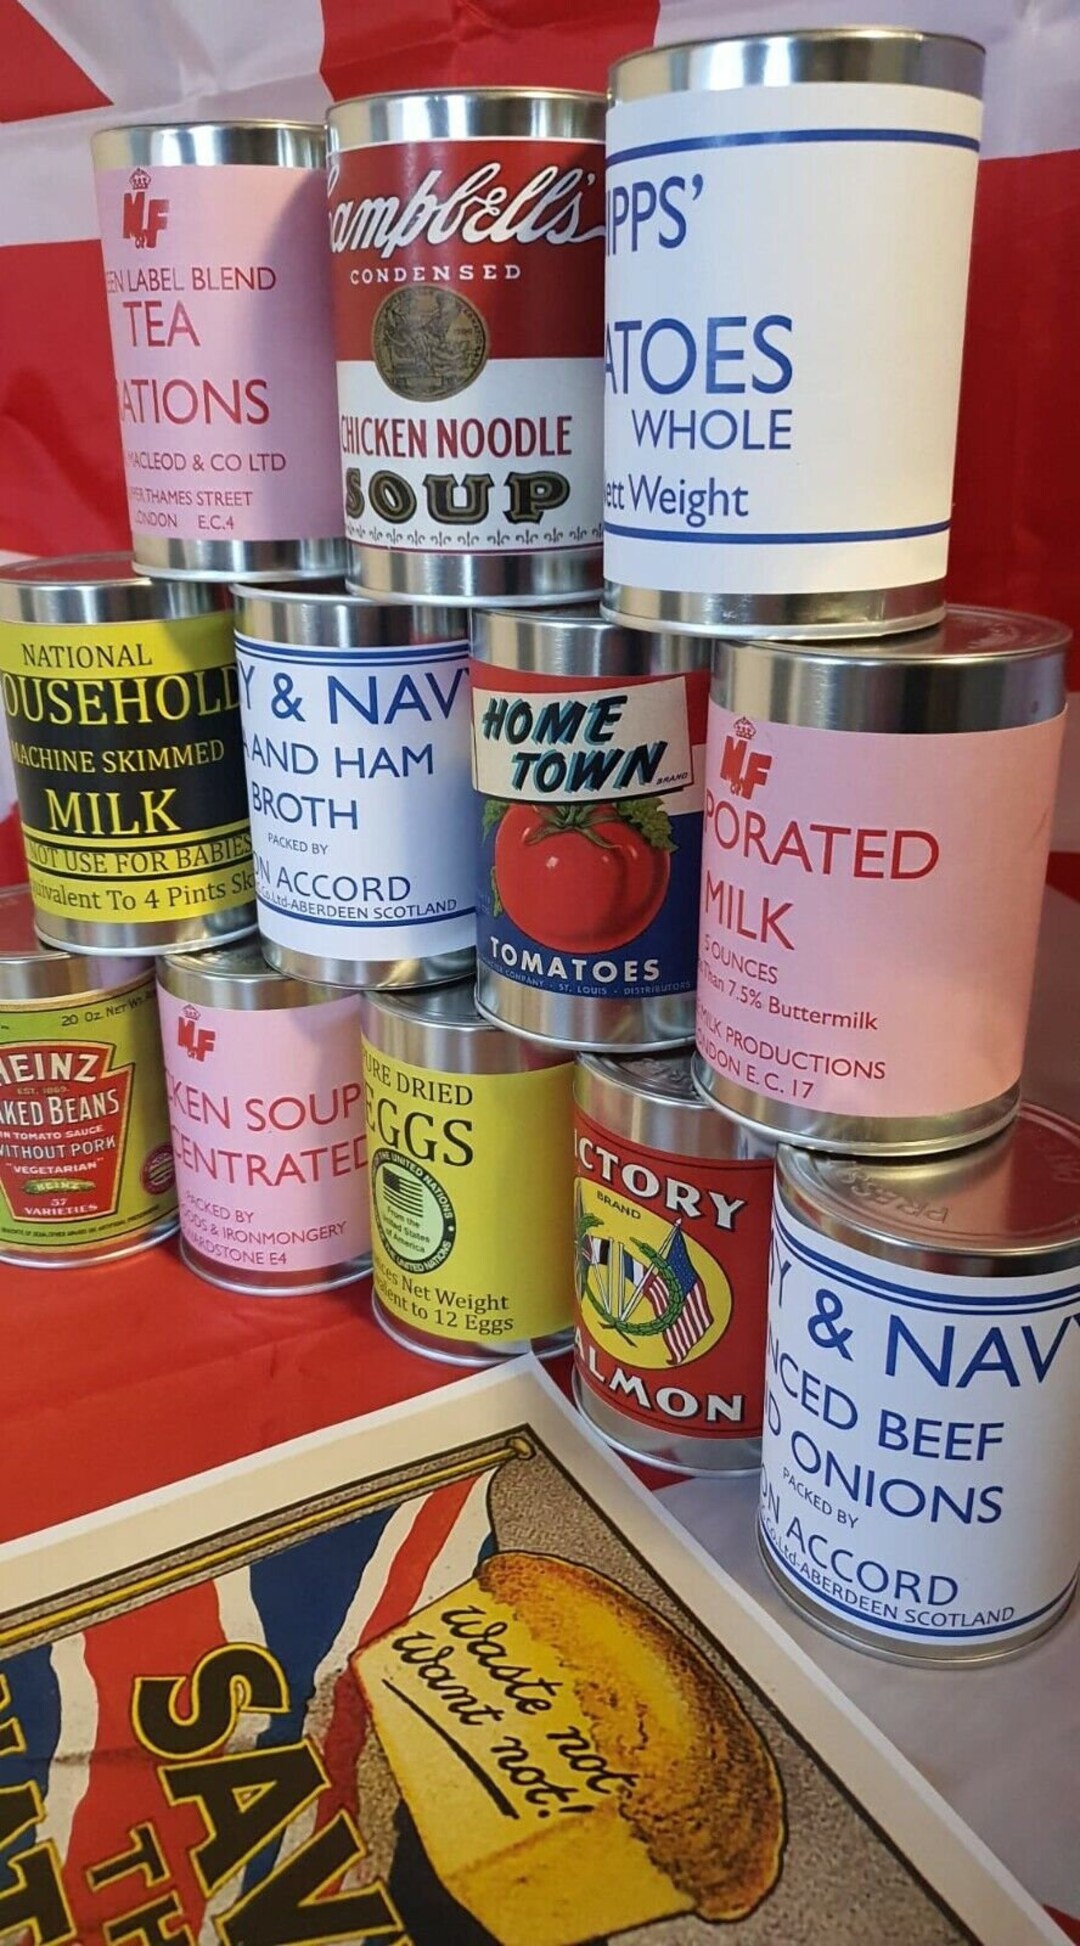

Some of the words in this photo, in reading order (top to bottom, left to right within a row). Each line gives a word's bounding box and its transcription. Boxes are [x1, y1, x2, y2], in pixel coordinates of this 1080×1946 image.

[128, 267, 185, 292] LABEL
[192, 266, 277, 292] BLEND
[350, 263, 521, 285] CONDENSED
[123, 300, 201, 348] TEA
[121, 378, 270, 425] ATIONS
[341, 416, 428, 458] CHICKEN
[438, 415, 573, 458] NOODLE
[631, 408, 793, 450] WHOLE
[193, 454, 205, 472] &
[210, 453, 243, 472] CO
[249, 453, 287, 472] LTD
[145, 488, 193, 506] THAMES
[196, 491, 254, 507] STREET
[345, 467, 571, 527] SOUP
[628, 474, 749, 527] Weight
[21, 643, 154, 668] NATIONAL
[271, 671, 307, 723] &
[327, 667, 470, 726] NAV
[482, 694, 629, 746] HOME
[11, 740, 96, 774] MACHINE
[102, 738, 225, 774] SKIMMED
[252, 733, 320, 775] AND
[335, 743, 434, 779] HAM
[511, 740, 669, 795] TOWN
[656, 771, 689, 786] BRAND
[44, 788, 182, 836] MILK
[252, 781, 359, 830] BROTH
[64, 850, 108, 874] USE
[115, 850, 169, 874] FOR
[175, 833, 253, 870] BABIES
[268, 832, 308, 853] PACKED
[311, 843, 329, 856] BY
[704, 788, 940, 881] PORATED
[106, 889, 136, 911] To
[144, 888, 160, 909] 4
[166, 883, 226, 907] Pints
[277, 865, 411, 903] ACCORD
[373, 898, 457, 920] SCOTLAND
[706, 870, 796, 951] MILK
[490, 935, 660, 984] TOMATOES
[711, 941, 779, 985] OUNCES
[577, 985, 608, 996] LOUIS
[624, 980, 691, 996] DISTRIBUTORS
[728, 979, 762, 1009] 7.5%
[769, 995, 878, 1031] Buttermilk
[61, 1014, 79, 1027] 20
[726, 1026, 886, 1082] PRODUCTIONS
[47, 1089, 120, 1125] BEANS
[245, 1083, 362, 1132] SOUP
[396, 1071, 473, 1106] DRIED
[791, 1079, 814, 1099] 17
[11, 1132, 62, 1140] TOMATO
[65, 1125, 104, 1138] SAUCE
[365, 1081, 474, 1167] EGGS
[71, 1135, 116, 1157] PORK
[391, 1152, 424, 1177] UNITED
[422, 1174, 454, 1220] NATIONS
[596, 1190, 642, 1221] BRAND
[24, 1205, 99, 1216] VARIETIES
[235, 1209, 254, 1223] BY
[222, 1220, 348, 1245] IRONMONGERY
[269, 1252, 287, 1266] E4
[424, 1240, 452, 1270] NATIONS
[402, 1275, 431, 1302] Net
[435, 1287, 510, 1315] Weight
[411, 1302, 428, 1320] to
[434, 1309, 458, 1328] 12
[465, 1314, 515, 1335] Eggs
[808, 1288, 854, 1362] &
[886, 1311, 1080, 1389] NAV
[574, 1327, 745, 1423] ALMON
[879, 1408, 1005, 1462] BEEF
[783, 1467, 832, 1516] PACKED
[837, 1508, 860, 1529] BY
[791, 1430, 1004, 1525] ONIONS
[786, 1516, 958, 1607] ACCORD
[904, 1606, 1015, 1628] SCOTLAND
[490, 1736, 595, 1818] not!
[546, 1726, 640, 1794] not
[131, 1641, 412, 1946] SAV
